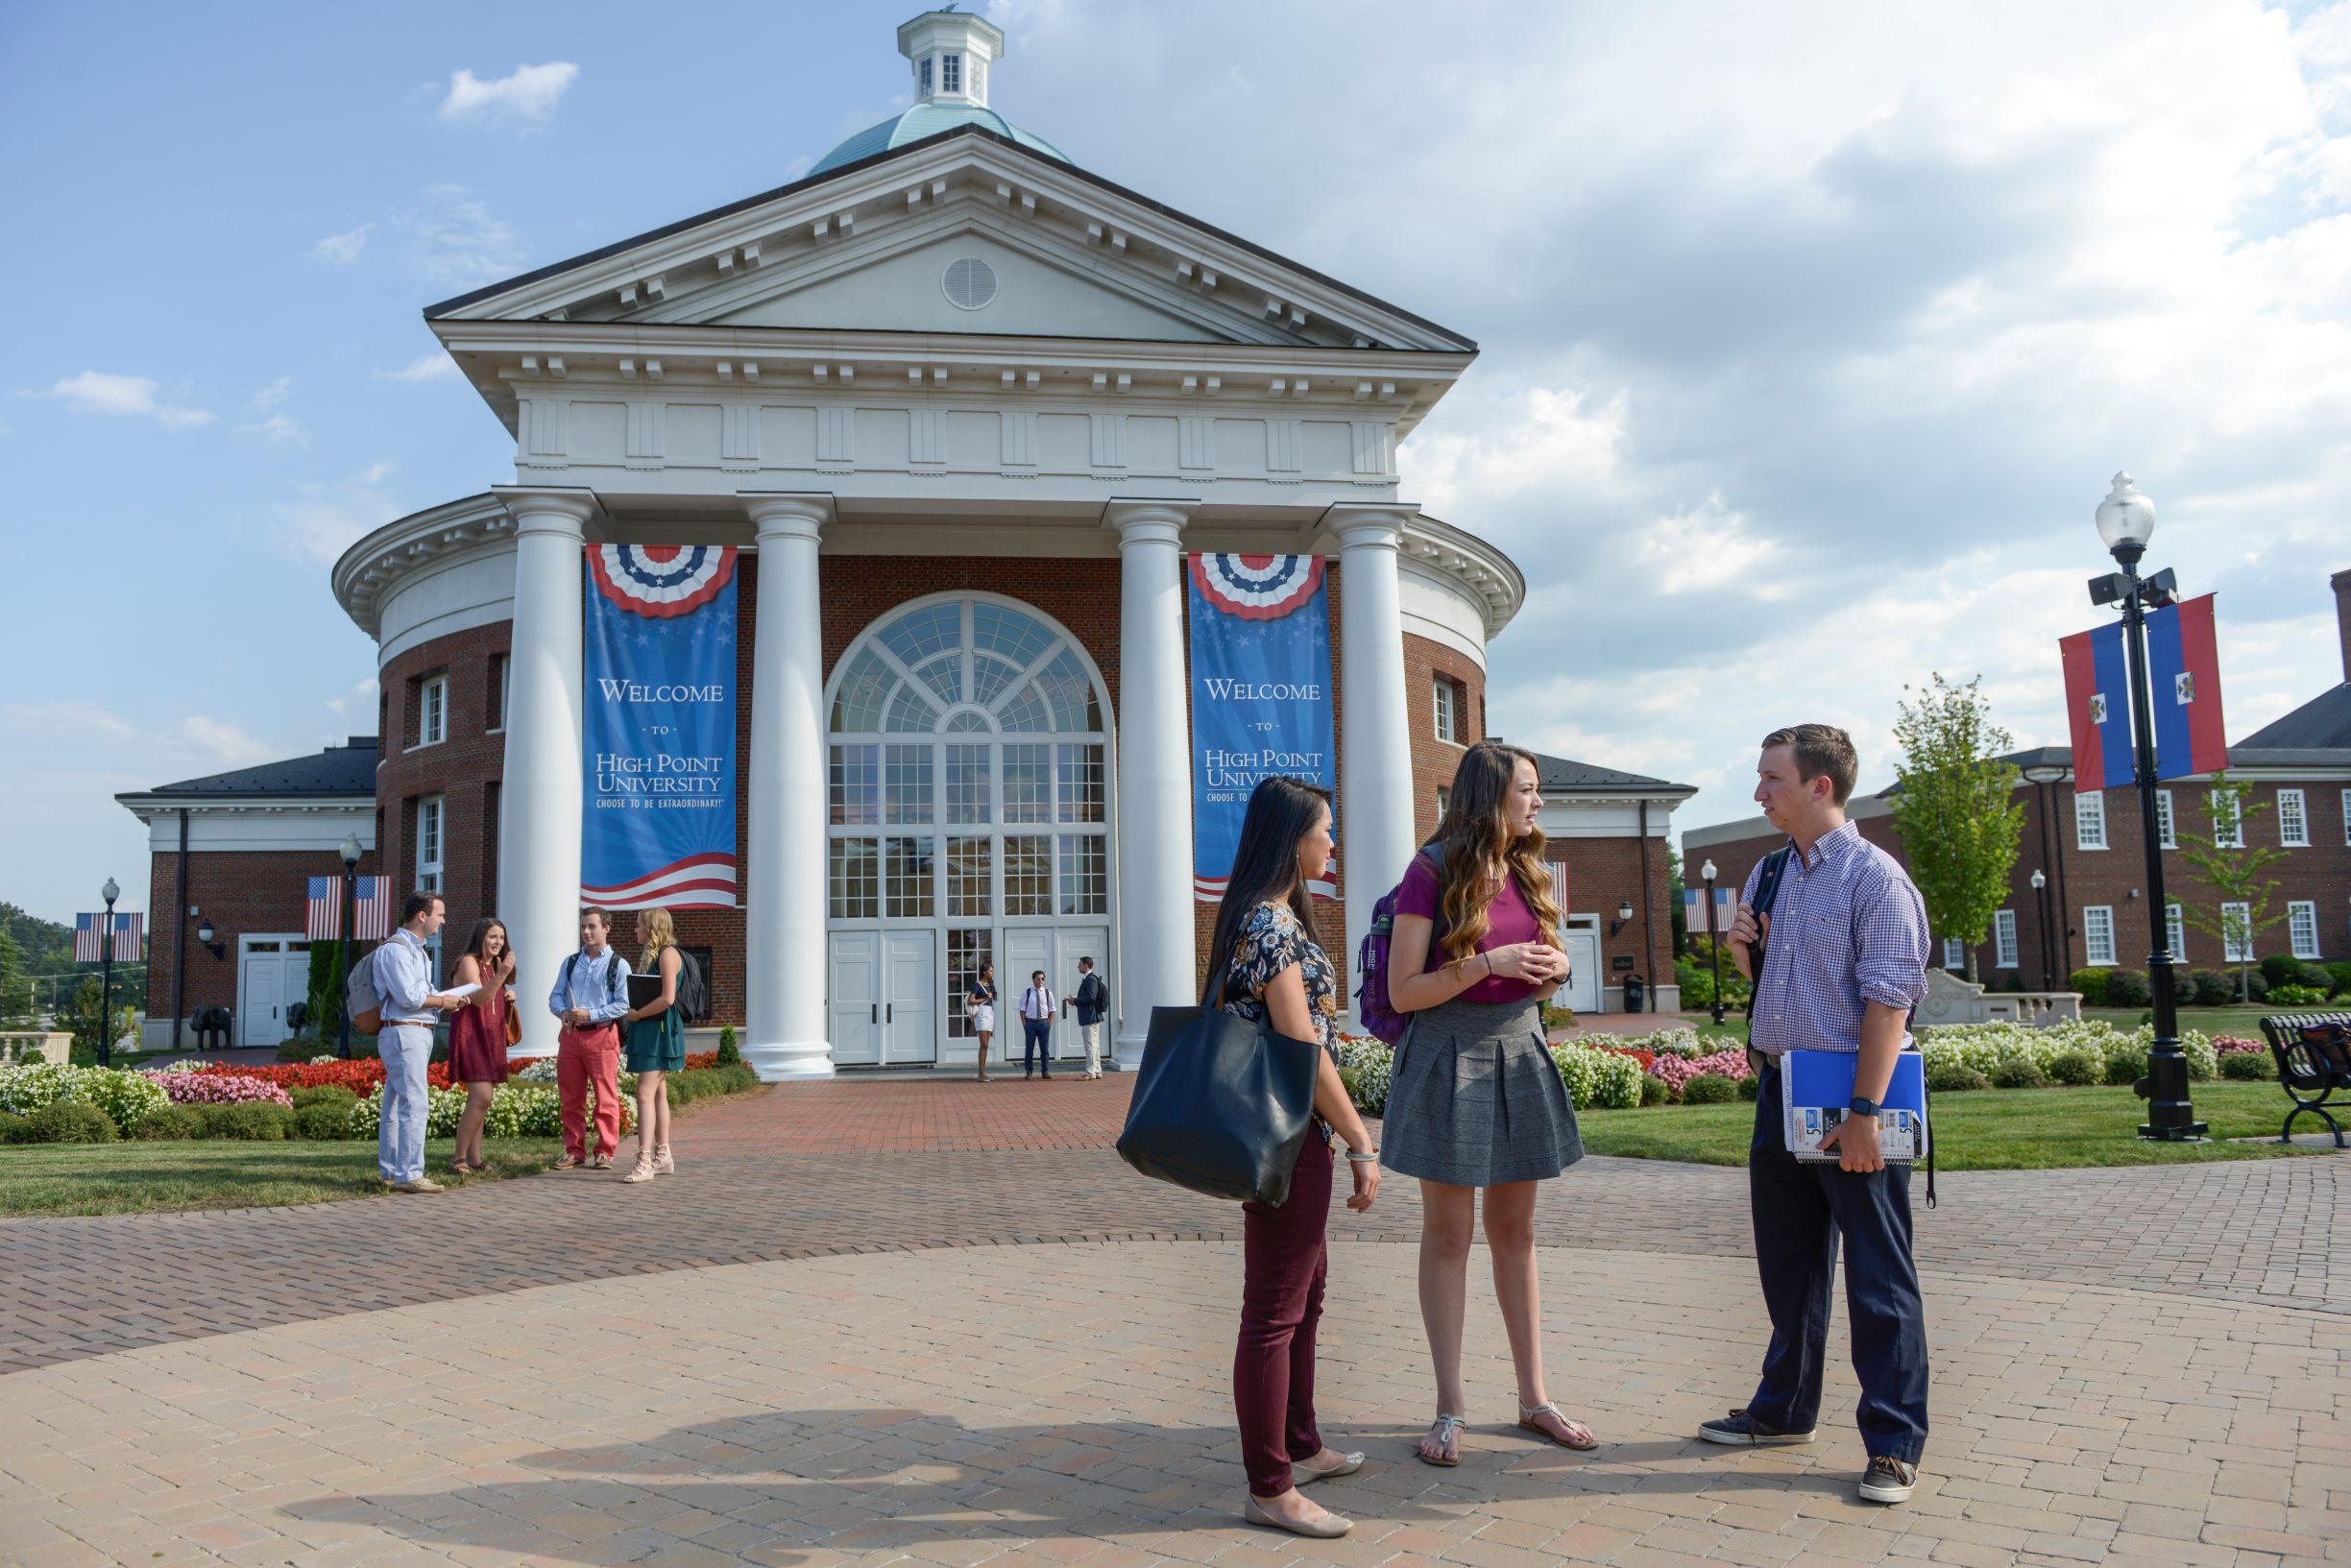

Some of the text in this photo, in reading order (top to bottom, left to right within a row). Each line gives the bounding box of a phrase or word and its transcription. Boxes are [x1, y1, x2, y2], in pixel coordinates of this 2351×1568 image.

[597, 678, 723, 703] WELCOME
[1203, 678, 1321, 701] WELCOME
[595, 753, 723, 773] HIGH POINT
[1205, 749, 1322, 767] HIGH POINT
[596, 773, 722, 792] UNIVERSITY
[596, 798, 626, 808] CHOOSE
[630, 799, 640, 808] TO
[644, 799, 654, 808] BE
[1206, 792, 1248, 803] CHOOSE TO
